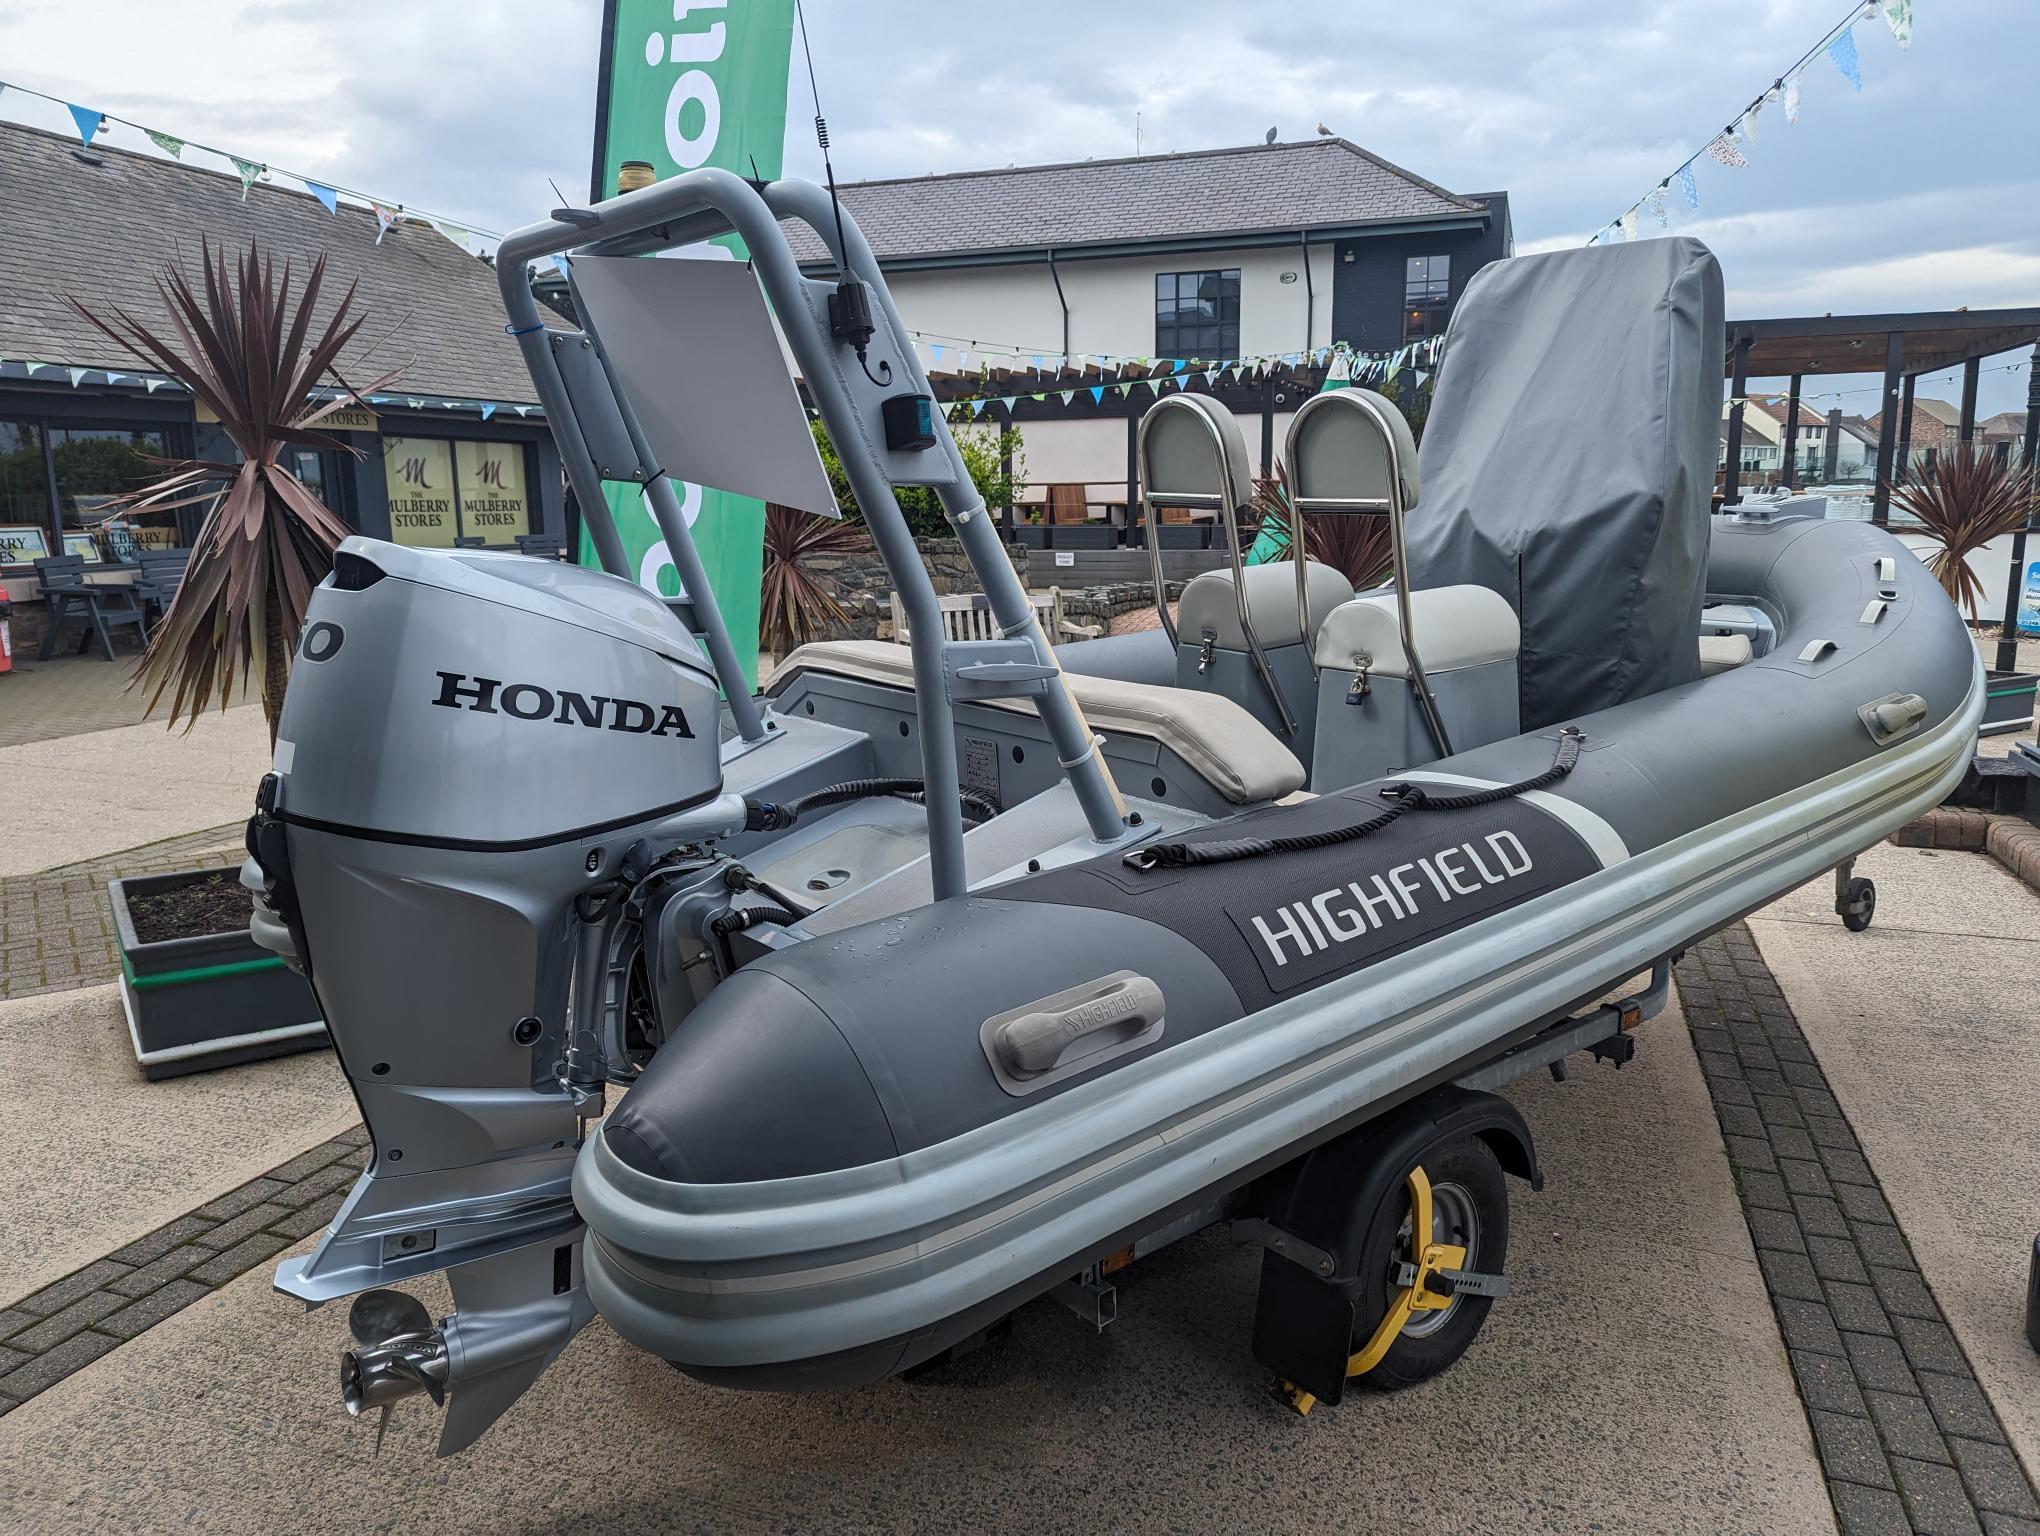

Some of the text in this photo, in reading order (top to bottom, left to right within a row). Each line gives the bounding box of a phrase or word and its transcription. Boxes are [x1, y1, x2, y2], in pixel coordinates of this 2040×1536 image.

[322, 411, 369, 426] STORES
[465, 499, 522, 512] MULBERRY
[395, 513, 442, 527] STORES
[475, 513, 515, 526] STORES
[0, 537, 26, 550] RRY
[0, 550, 16, 563] ES
[431, 670, 696, 740] HONDA
[1251, 830, 1534, 967] HIGHFIELD
[1078, 992, 1138, 1029] HIGHFIELD
